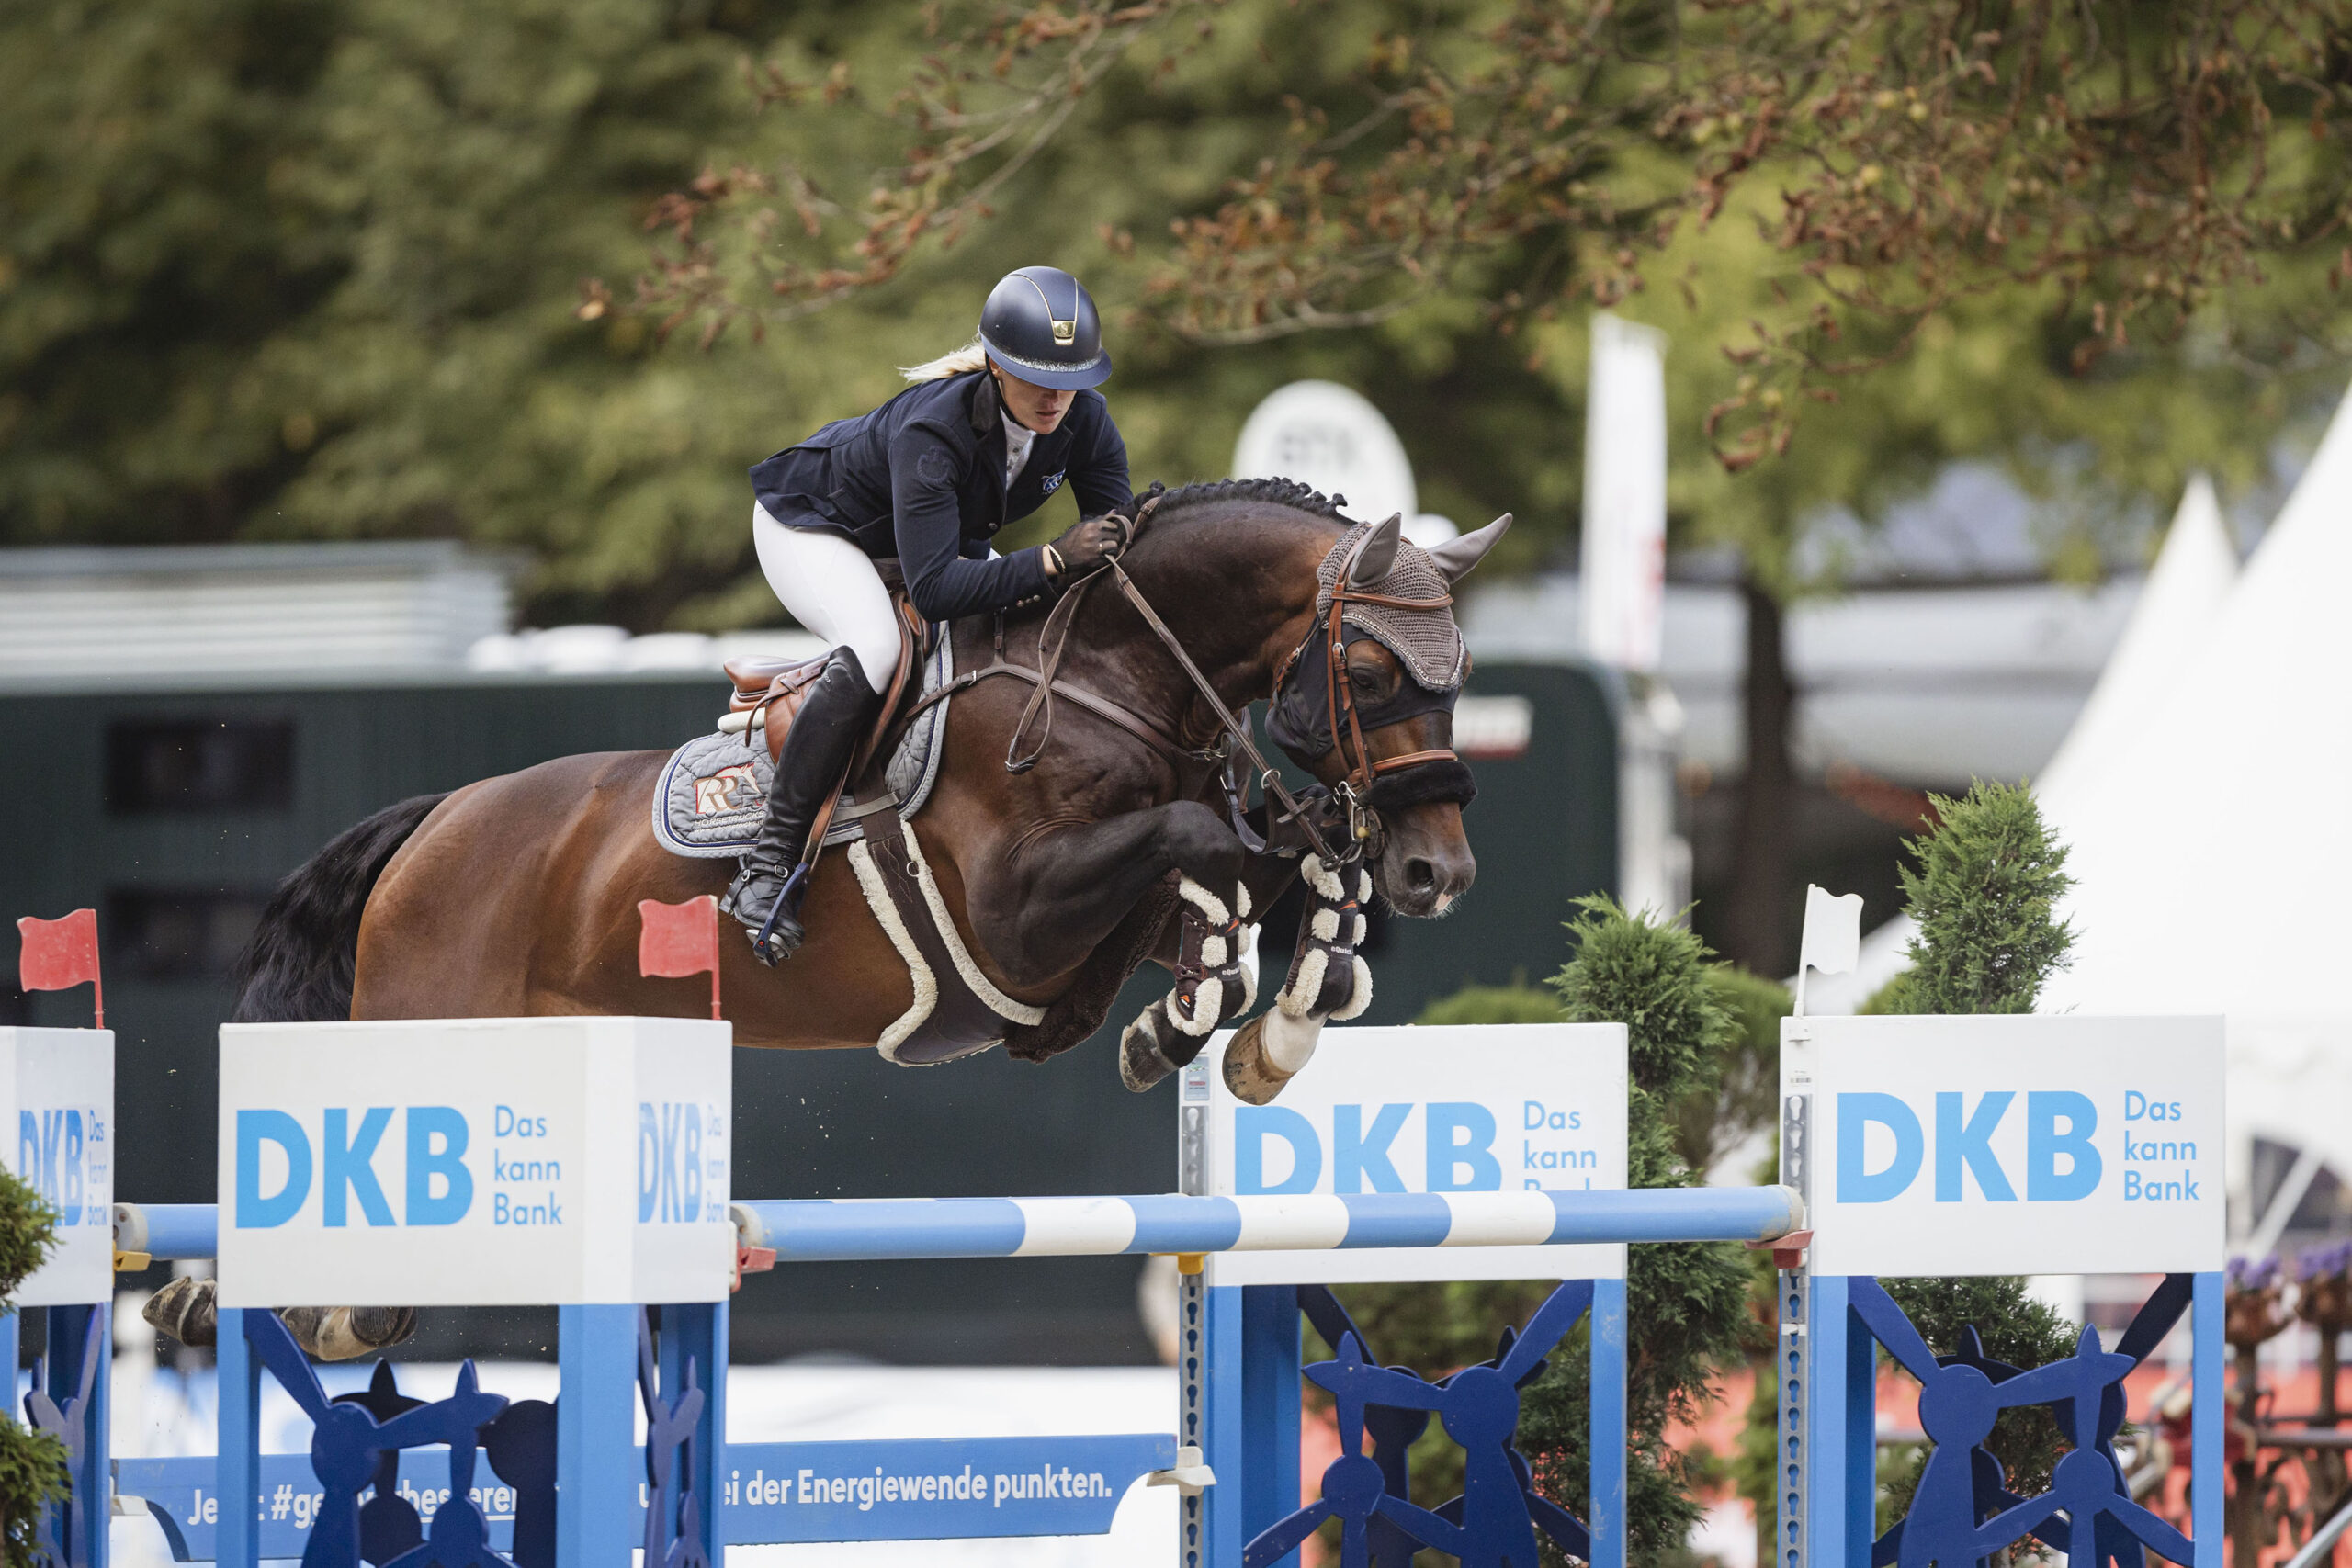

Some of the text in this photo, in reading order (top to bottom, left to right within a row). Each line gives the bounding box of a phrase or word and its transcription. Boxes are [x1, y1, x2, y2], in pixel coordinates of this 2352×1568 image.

[494, 1103, 548, 1138] Das
[1523, 1100, 1582, 1131] Das
[2123, 1090, 2183, 1122] Das
[88, 1109, 105, 1142] Das
[637, 1101, 703, 1224] DKB
[1235, 1101, 1503, 1193] DKB
[1523, 1138, 1598, 1170] kann
[1837, 1090, 2103, 1204] DKB
[2123, 1129, 2198, 1162] kann
[18, 1109, 84, 1227] DKB
[235, 1105, 474, 1229] DKB
[494, 1147, 561, 1181] kann
[2123, 1168, 2200, 1201] Bank
[493, 1190, 563, 1226] Bank
[745, 1469, 792, 1506] der
[797, 1465, 988, 1512] Energiewende
[993, 1462, 1113, 1508] punkten.
